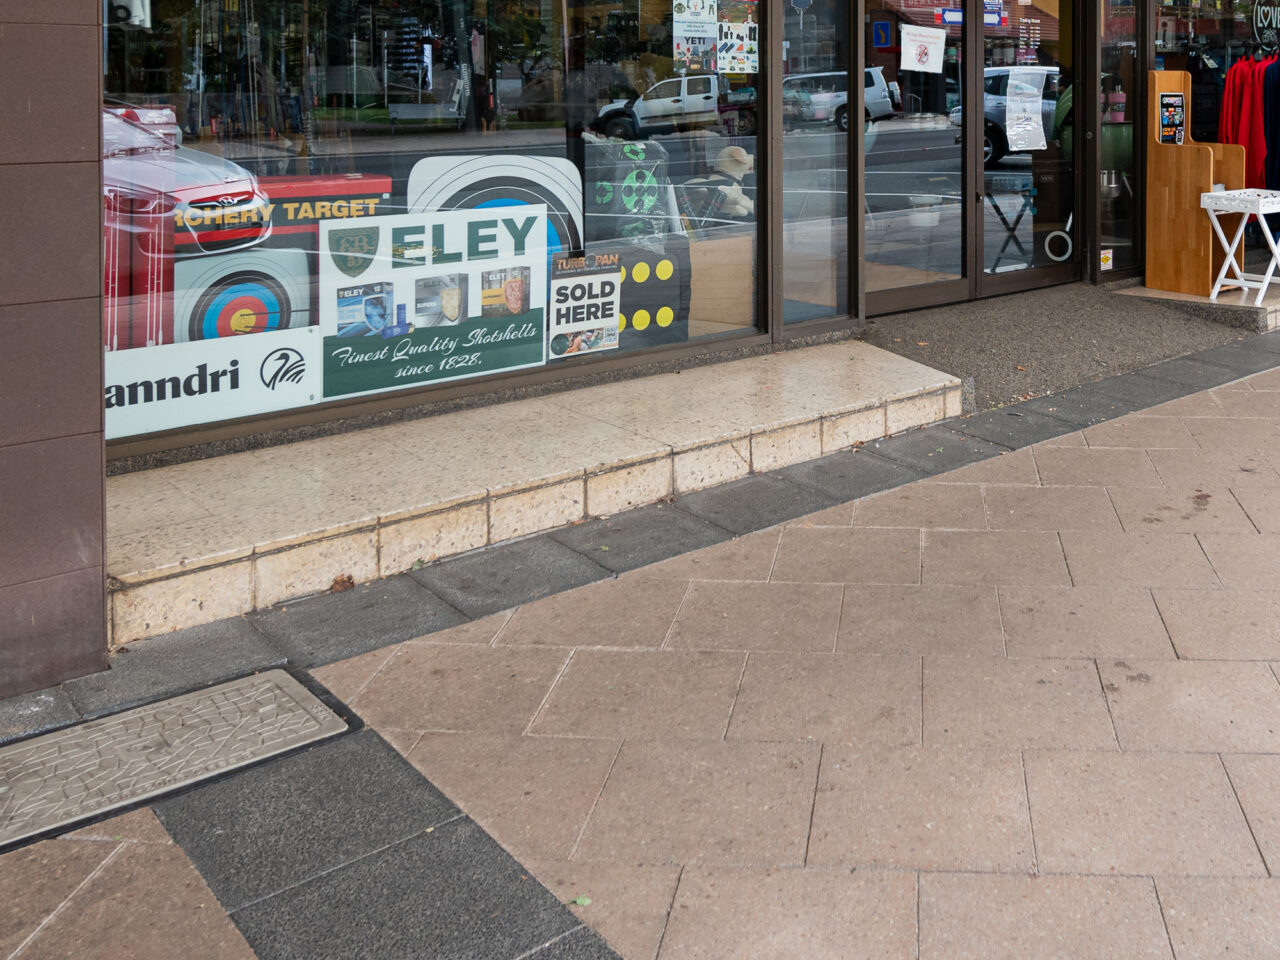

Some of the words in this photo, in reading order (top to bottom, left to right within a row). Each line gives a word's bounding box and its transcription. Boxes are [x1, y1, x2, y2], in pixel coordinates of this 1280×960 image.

[684, 36, 706, 46] YETI
[173, 204, 275, 228] RCHERY
[283, 198, 380, 220] TARGET
[392, 216, 538, 269] ELEY
[344, 288, 364, 298] ELEY
[555, 280, 616, 304] SOLD
[556, 301, 615, 326] HERE
[332, 345, 389, 367] Finest
[391, 337, 459, 362] Quality
[462, 323, 538, 347] Shotshells
[394, 361, 434, 378] since
[438, 351, 482, 371] 1828.
